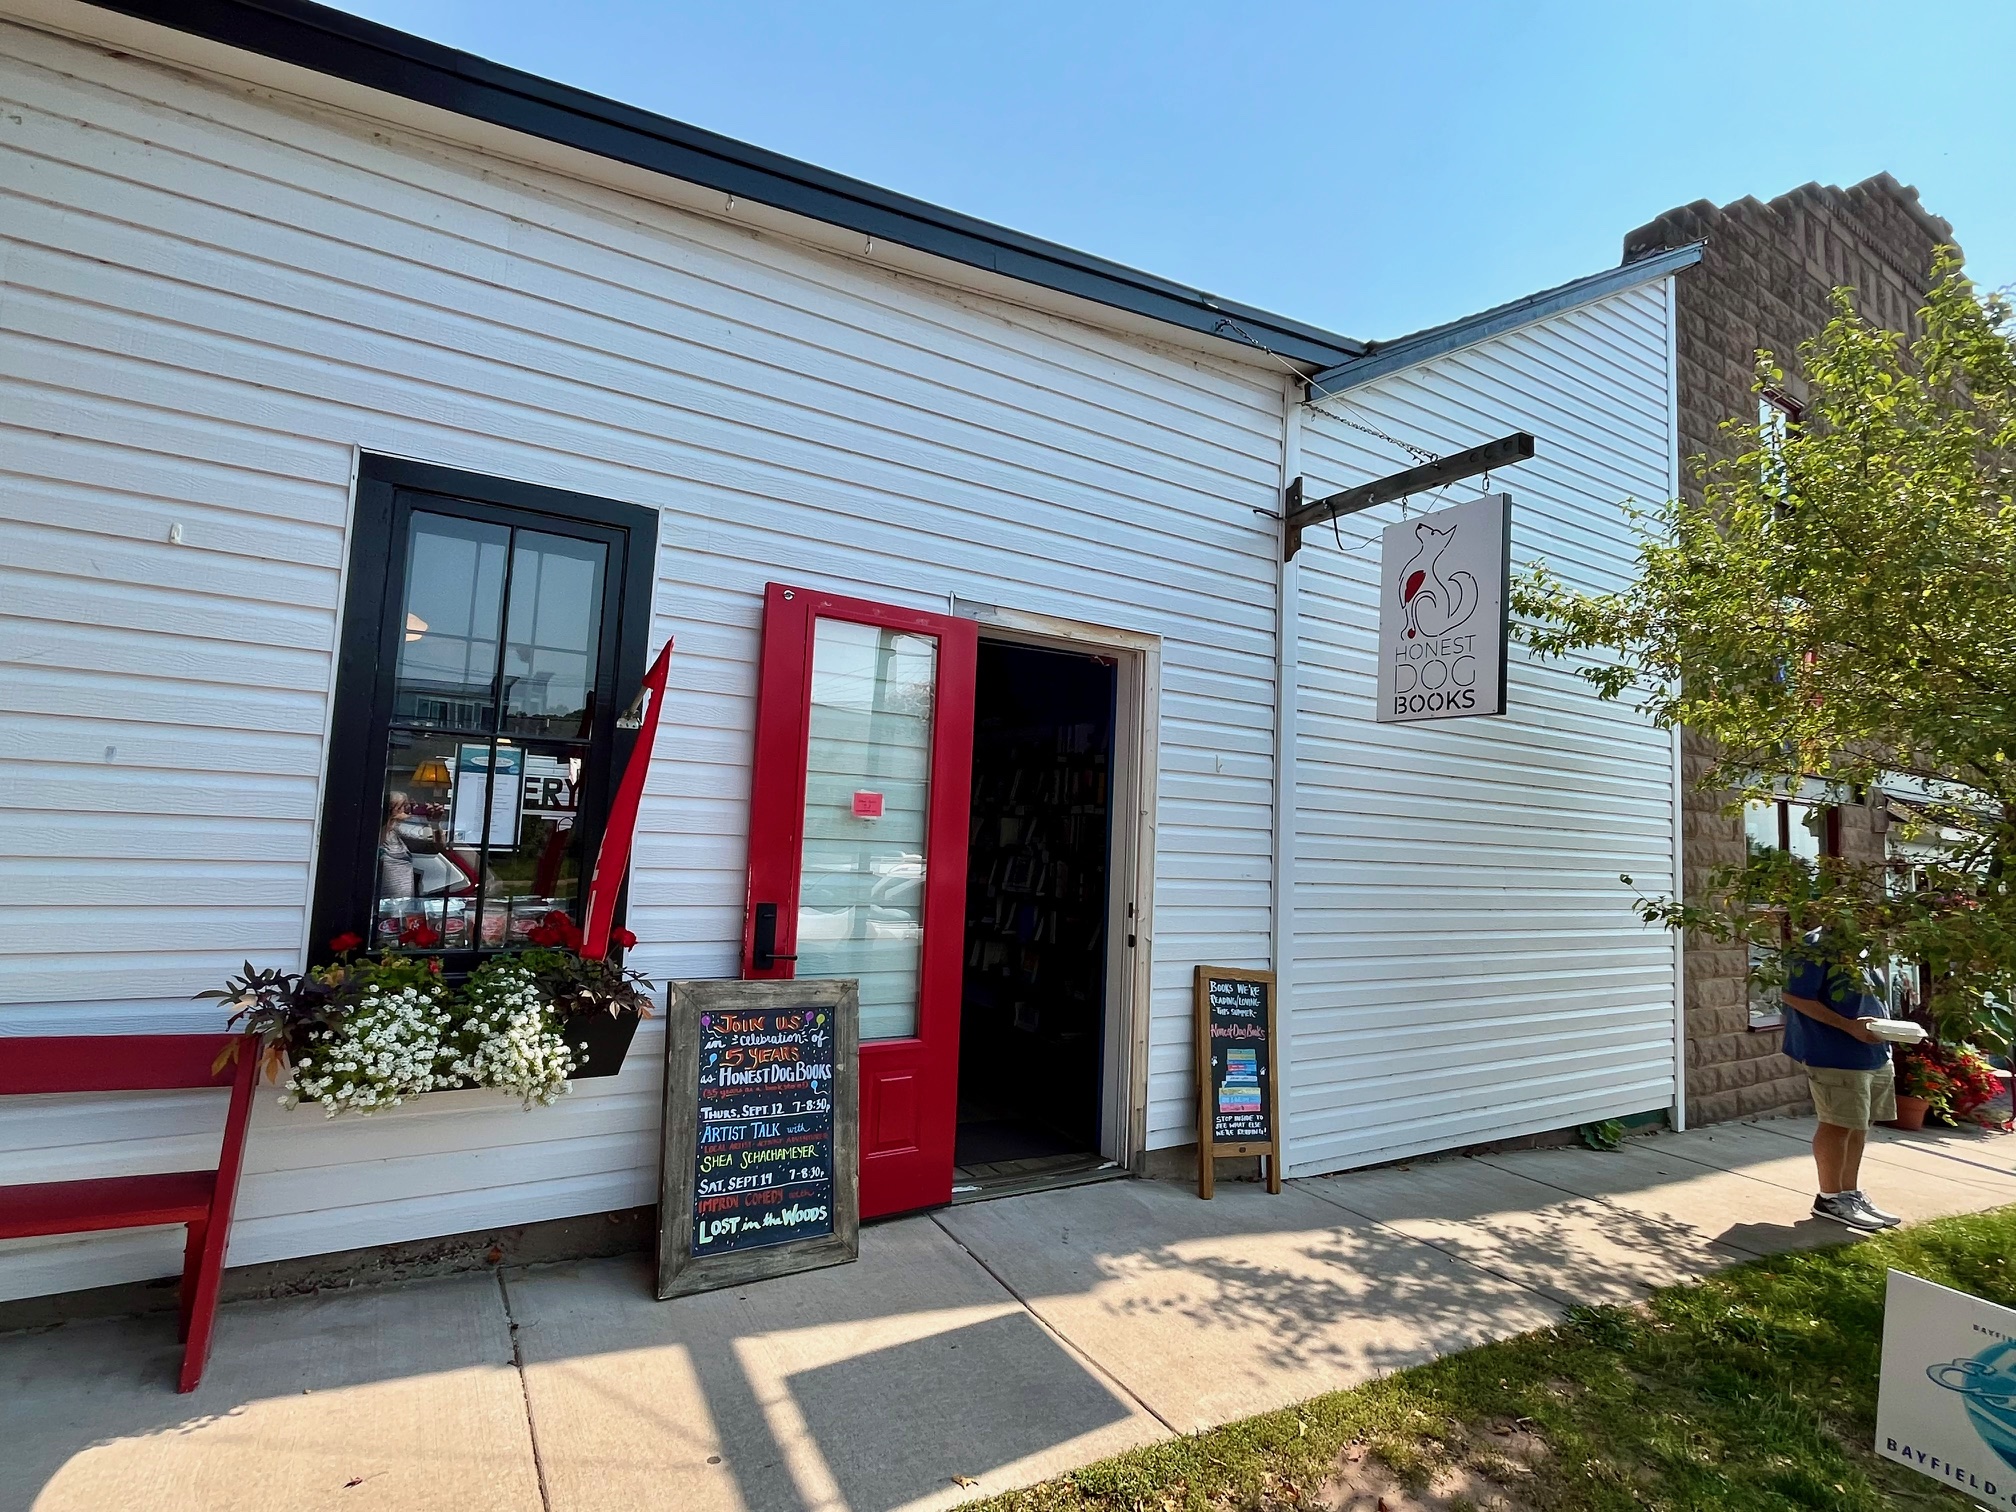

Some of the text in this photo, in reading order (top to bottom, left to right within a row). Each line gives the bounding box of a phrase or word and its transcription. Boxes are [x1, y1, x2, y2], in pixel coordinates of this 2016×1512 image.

[1395, 634, 1476, 663] HONEST
[1394, 655, 1475, 694] DOG
[1394, 689, 1475, 714] BOOKS
[713, 1014, 802, 1034] JOIN US
[739, 1032, 804, 1047] celebration
[811, 1029, 829, 1047] of
[719, 1046, 800, 1071] 5 YEARS
[719, 1066, 770, 1087] HONEST
[771, 1063, 795, 1084] DOG
[795, 1060, 832, 1081] BOOKS
[700, 1106, 740, 1120] THURS.
[771, 1102, 784, 1115] 12
[700, 1121, 811, 1143] ARTIST TALK with
[700, 1153, 733, 1173] SHEA
[699, 1203, 828, 1245] LOST in the WOODS
